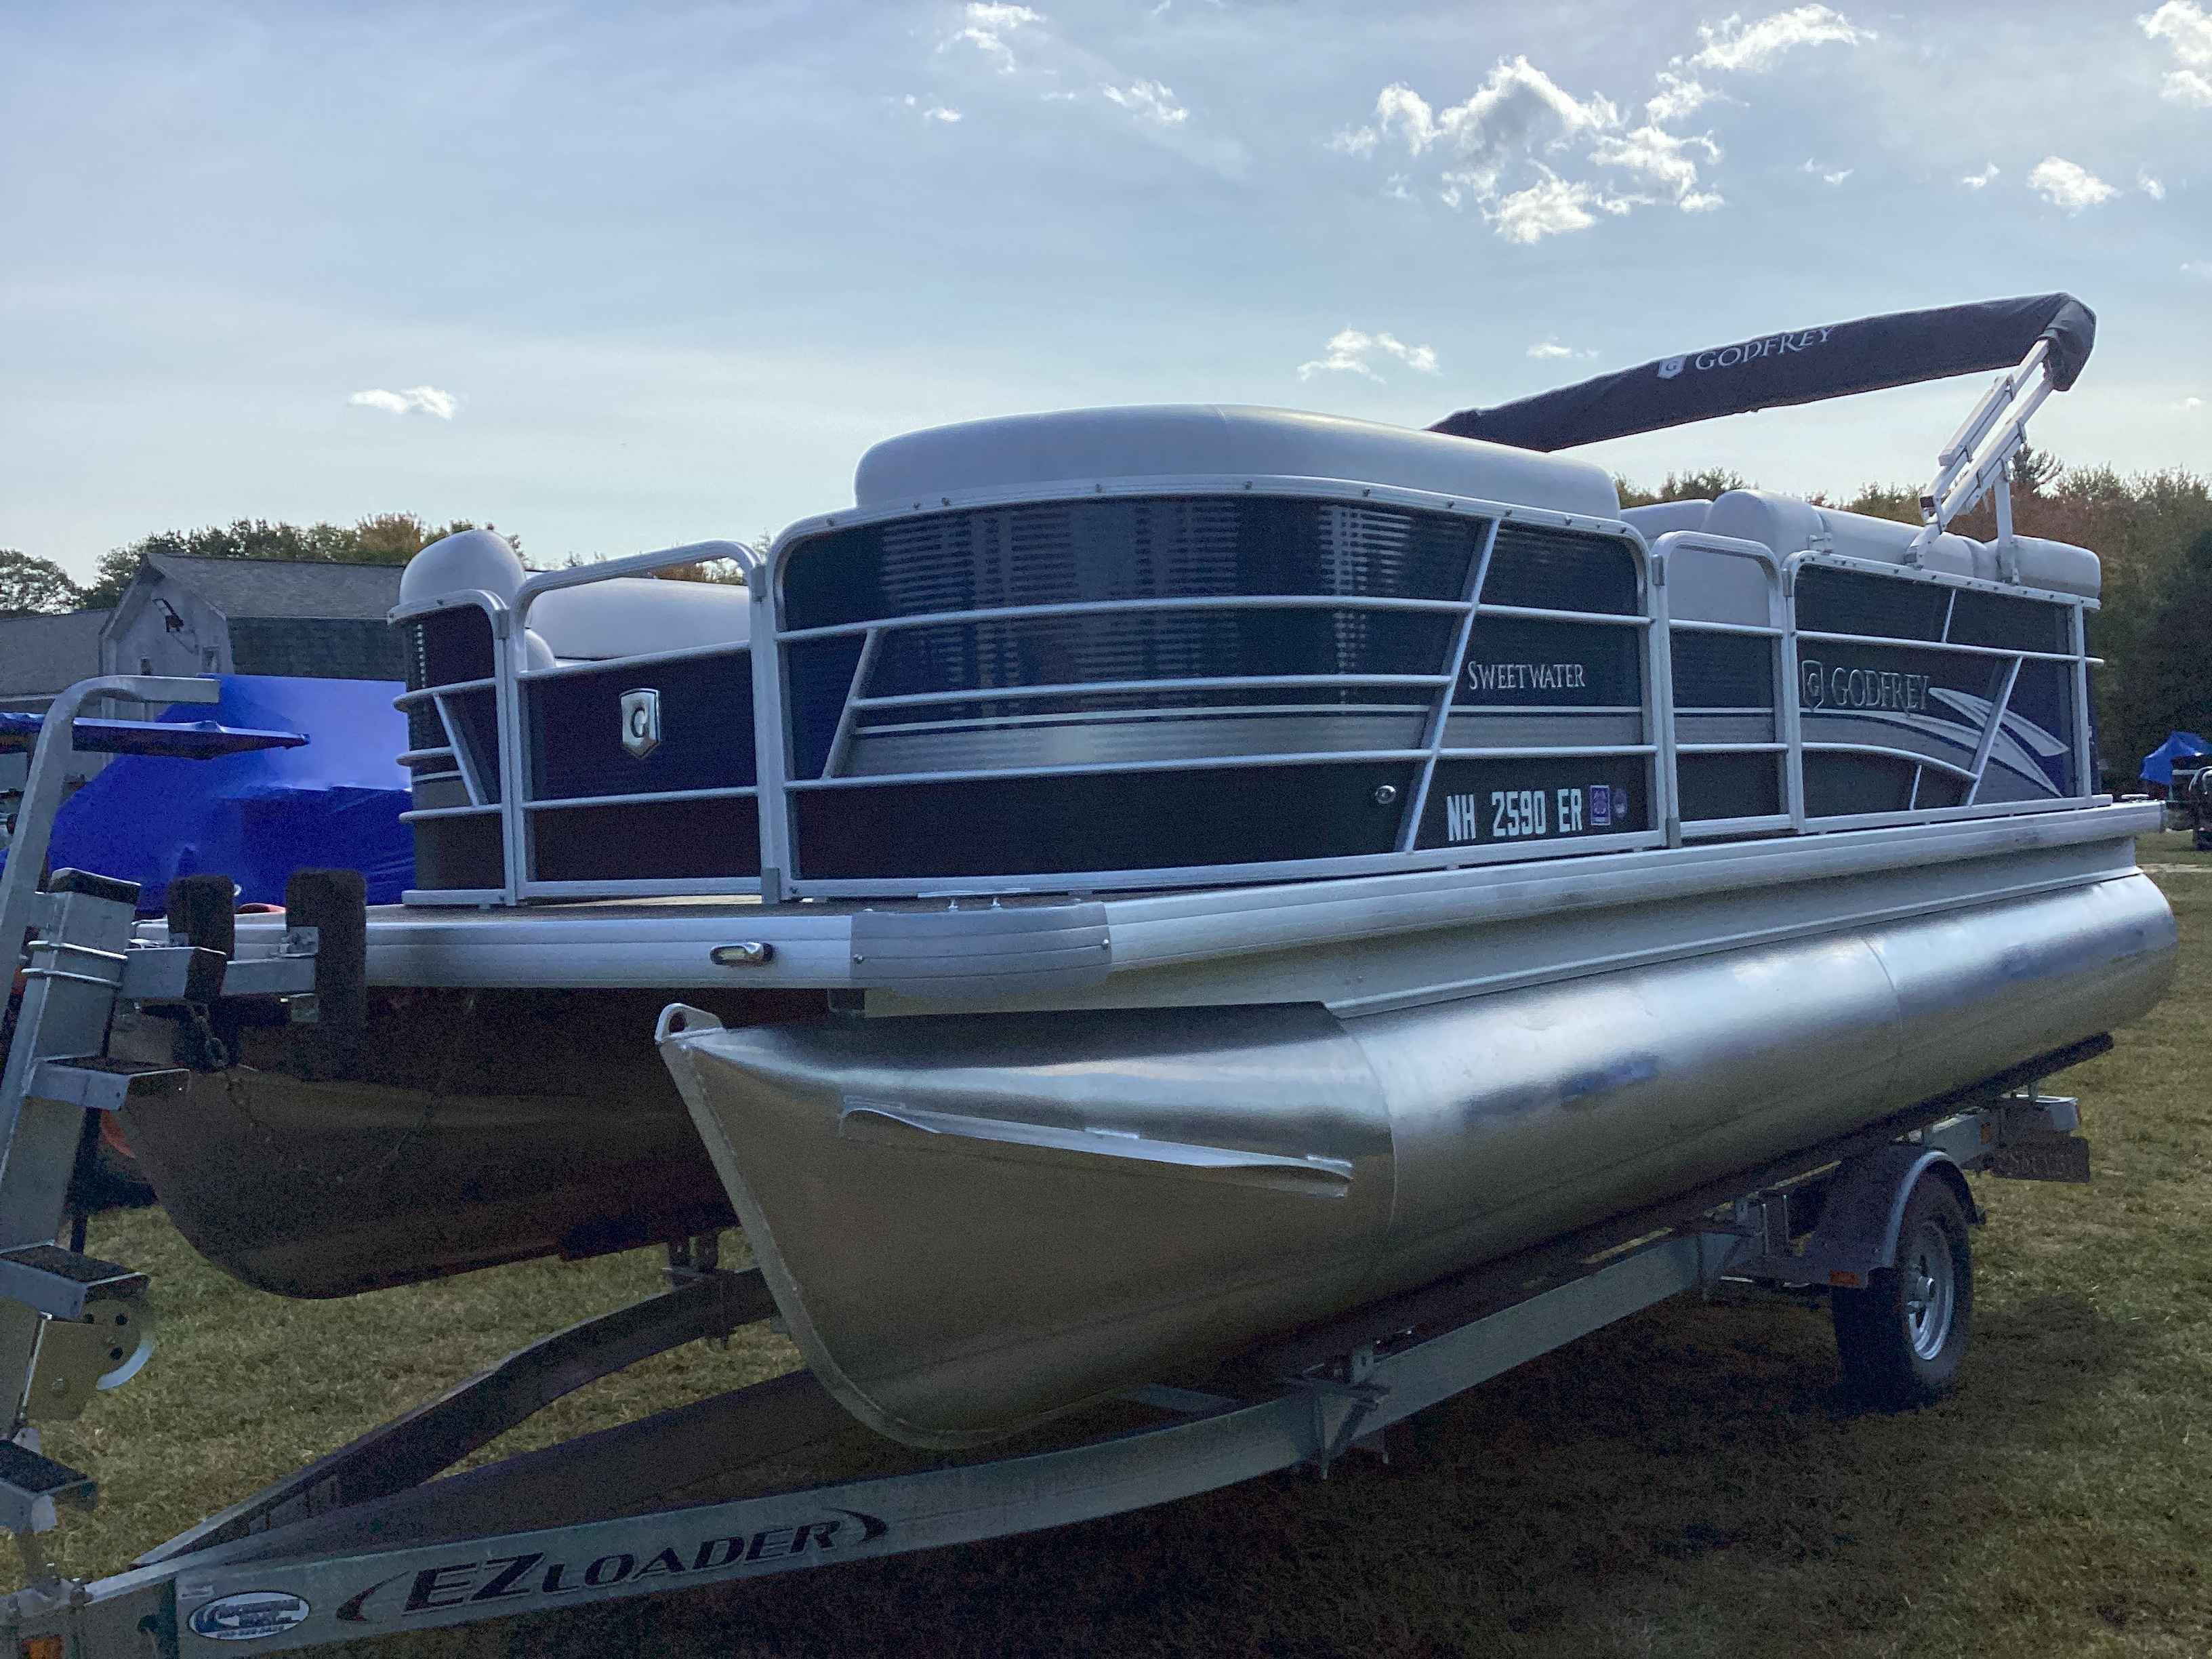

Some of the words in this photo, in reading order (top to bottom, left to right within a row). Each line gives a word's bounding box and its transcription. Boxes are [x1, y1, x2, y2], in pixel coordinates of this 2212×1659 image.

[1695, 326, 1835, 370] GODFREY
[1831, 667, 1930, 718] GODFREY
[1446, 794, 1476, 841] NH
[1491, 790, 1547, 837] 2590
[1557, 788, 1583, 834] ER
